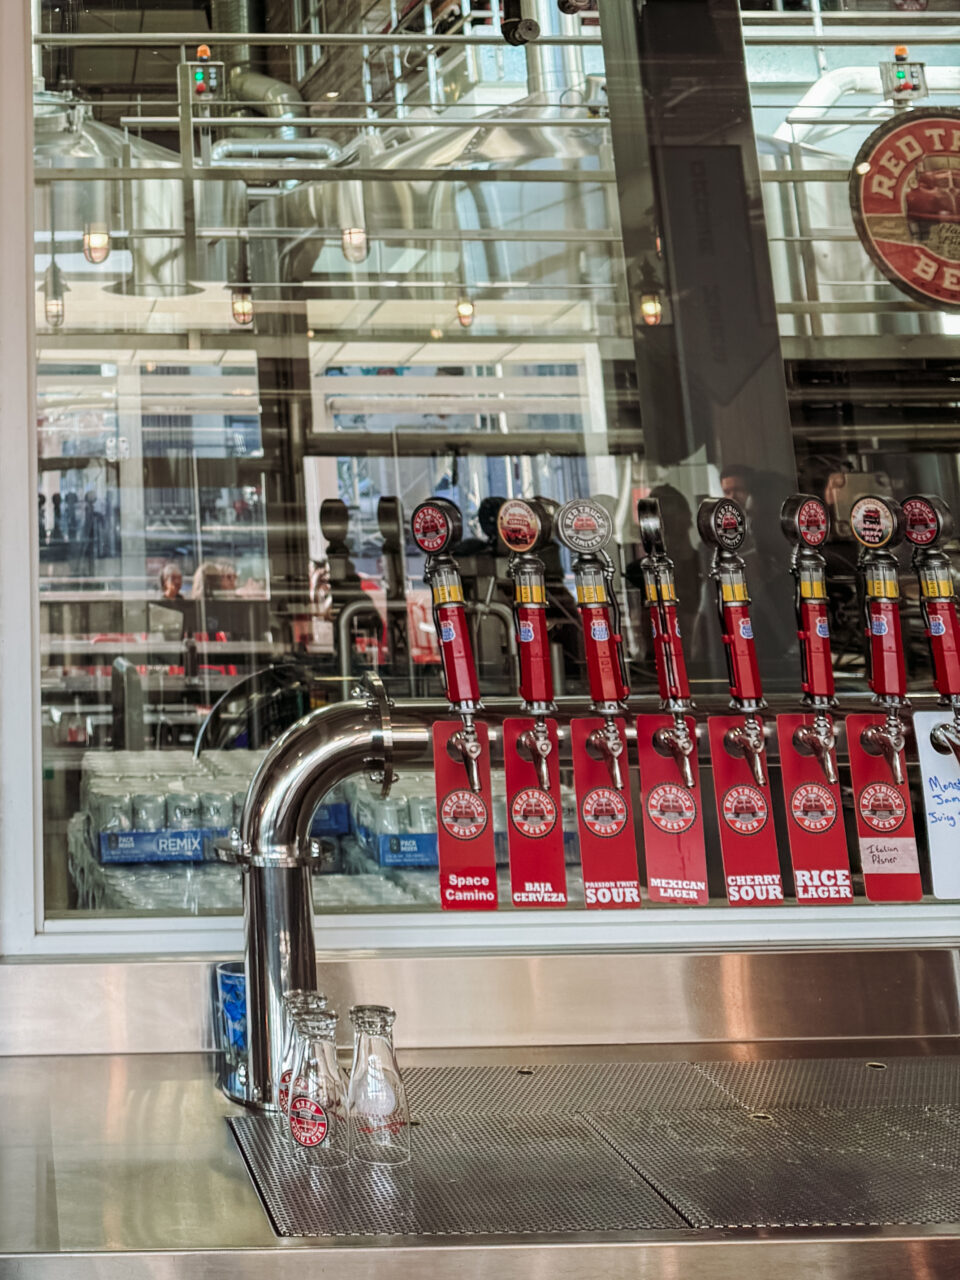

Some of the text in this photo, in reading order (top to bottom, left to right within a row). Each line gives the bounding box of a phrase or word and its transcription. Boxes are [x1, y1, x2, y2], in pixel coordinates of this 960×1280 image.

[871, 133, 925, 199] RED
[566, 506, 605, 525] RED TRUCK
[912, 502, 934, 519] TRUCK
[572, 535, 602, 547] LIMITED
[912, 532, 932, 541] BEER
[515, 791, 553, 811] RED TRUCK
[585, 791, 623, 811] RED TRUCK
[651, 787, 692, 807] RED TRUCK
[725, 788, 764, 808] RED TRUCK
[794, 787, 833, 806] RED TRUCK
[862, 786, 901, 805] RED TRUCK
[445, 793, 483, 813] RED TRUCK
[523, 824, 546, 834] BEER
[594, 824, 617, 833] BEER
[660, 820, 685, 830] BEER
[735, 821, 758, 831] BEER
[803, 819, 827, 829] BEER
[871, 818, 897, 828] BEER
[453, 826, 477, 836] BEER
[159, 838, 201, 851] REMIX
[866, 844, 899, 854] Italian
[871, 854, 897, 864] Pilsner
[449, 873, 489, 887] Space
[727, 874, 781, 886] CHERRY
[795, 869, 850, 886] RICE
[525, 882, 552, 893] BAJA
[650, 878, 706, 891] MEXICAN
[445, 889, 495, 901] Camino
[513, 892, 566, 903] CERVEZA
[585, 888, 639, 904] SOUR
[659, 888, 698, 900] LAGER
[728, 885, 783, 901] SOUR
[797, 885, 853, 899] LAGER
